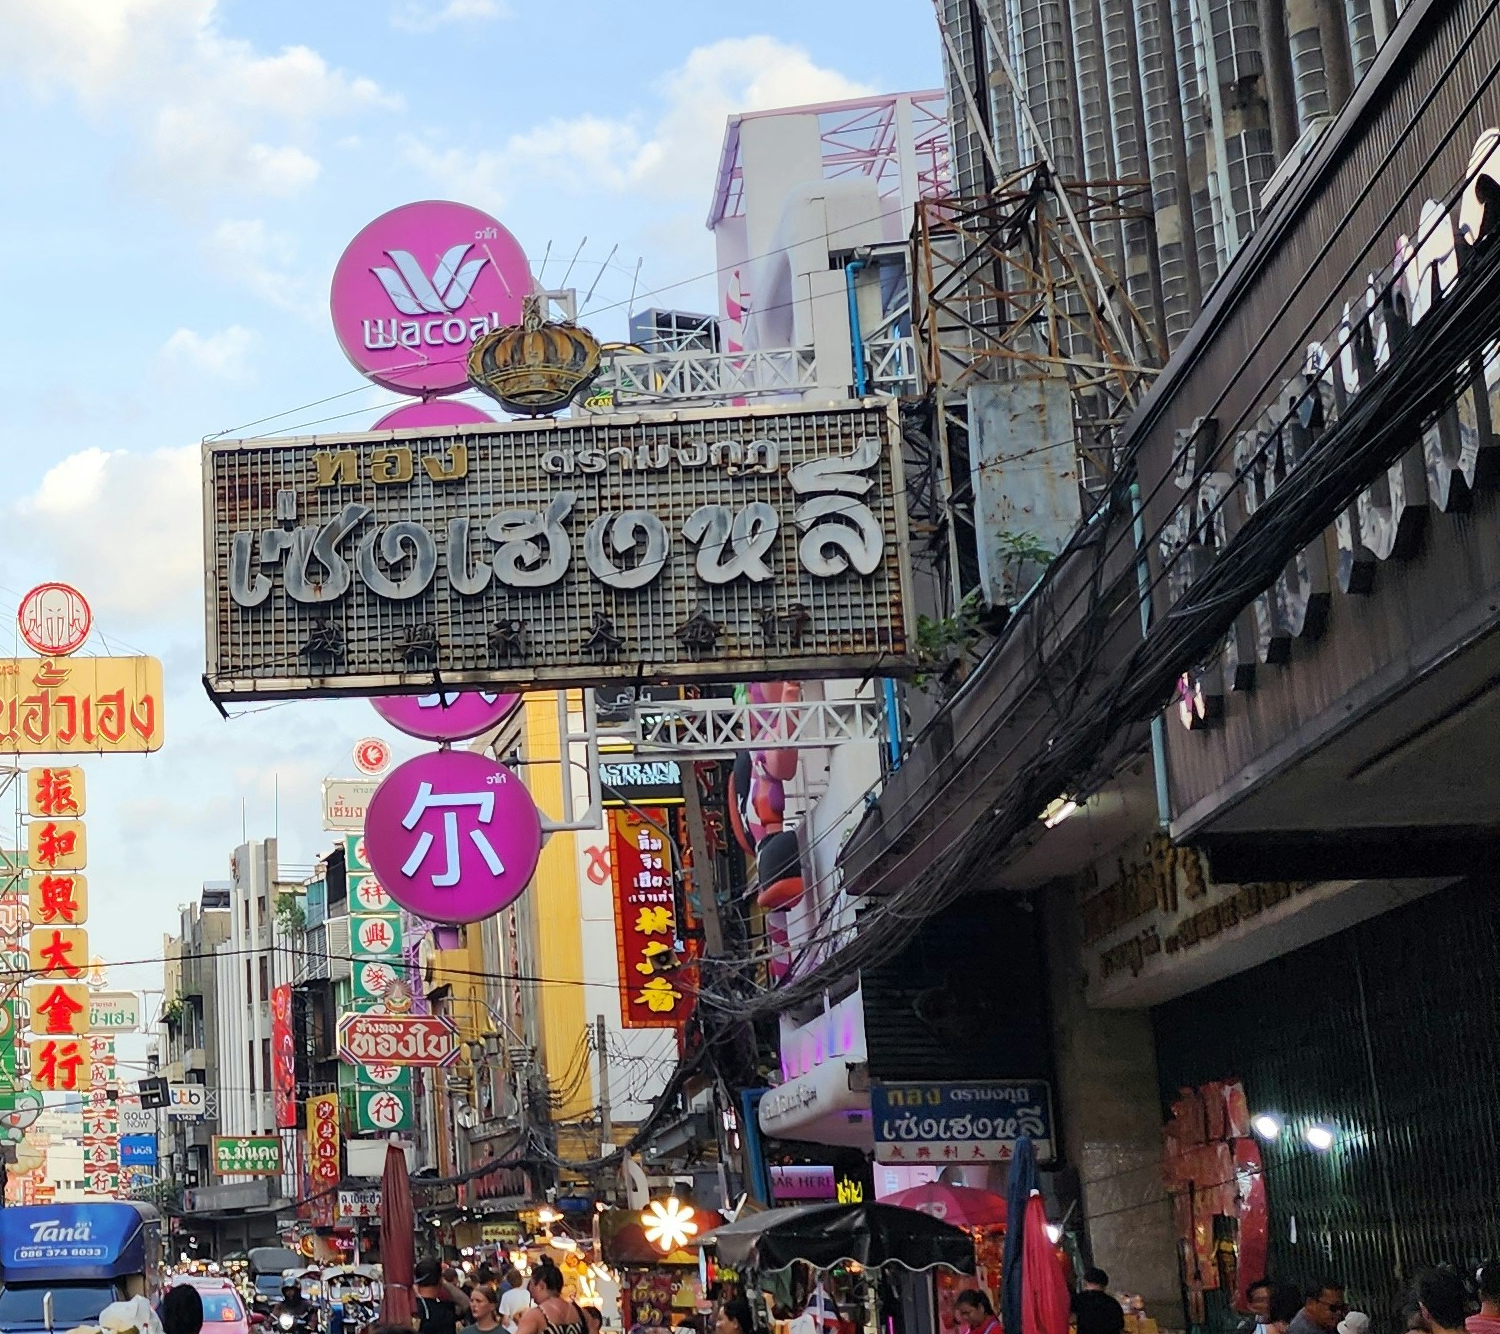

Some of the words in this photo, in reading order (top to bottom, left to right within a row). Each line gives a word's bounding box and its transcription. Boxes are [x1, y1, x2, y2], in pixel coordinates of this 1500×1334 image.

[313, 444, 469, 488] ทอง
[540, 439, 780, 478] ตรามงกุฎ
[35, 768, 85, 1091] 振和興大金行
[350, 1023, 449, 1059] ทองใบ
[170, 1089, 201, 1105] ttb
[123, 1111, 151, 1120] GOLD
[126, 1119, 149, 1128] NOW
[890, 1144, 1041, 1159] 成興利大金
